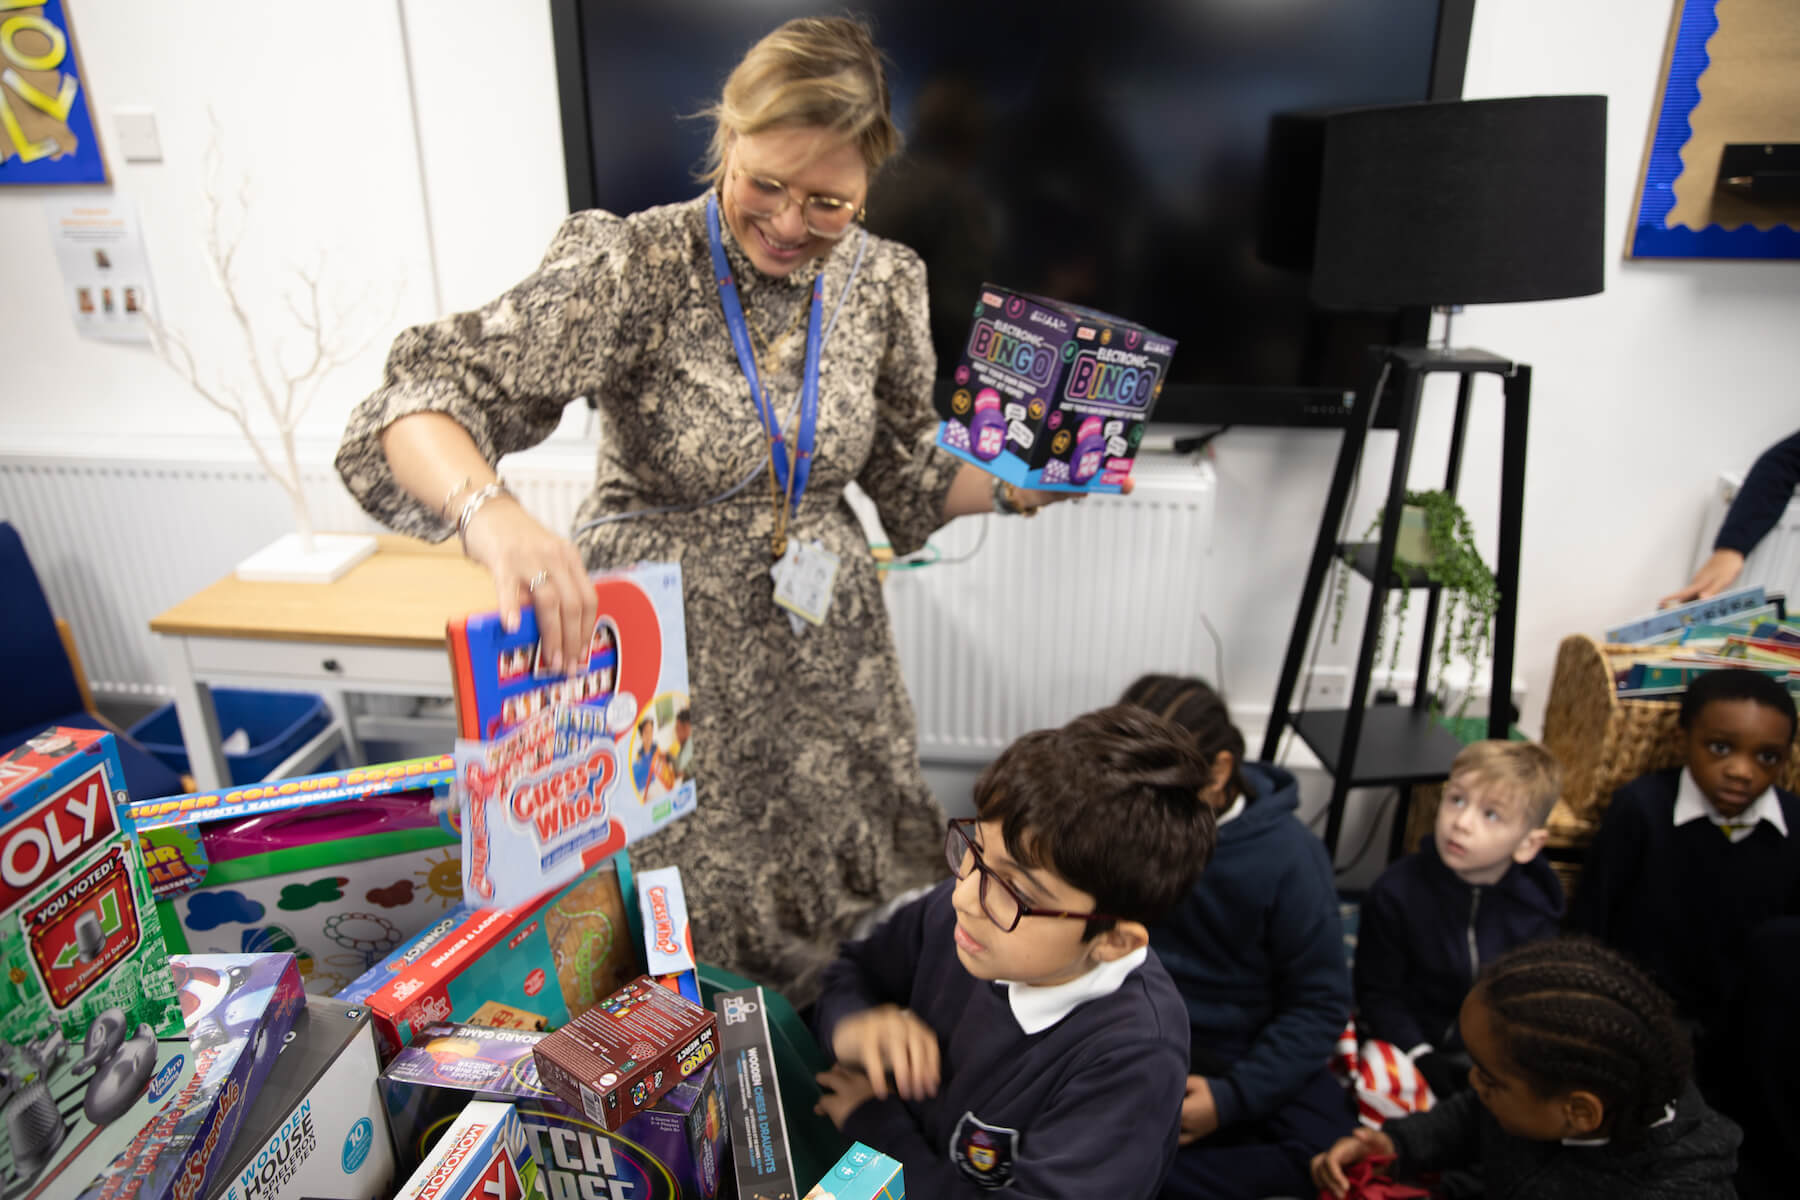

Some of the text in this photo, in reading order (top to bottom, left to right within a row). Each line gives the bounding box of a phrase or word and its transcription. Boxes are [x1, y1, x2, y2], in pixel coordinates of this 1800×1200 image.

[972, 324, 1054, 381] BINGO
[994, 319, 1045, 348] ELECTRONIC
[1096, 346, 1150, 368] ELECTRONIC
[1070, 356, 1155, 405] BINGO
[225, 776, 340, 804] COLOUR
[38, 858, 114, 924] YOU VOTED!
[456, 1027, 494, 1040] GAME
[676, 1027, 713, 1063] NO MERCY
[680, 1039, 715, 1076] UNO
[747, 1047, 762, 1086] WOODEN
[753, 1086, 767, 1115] CHESS
[190, 1080, 240, 1190] Scramble
[240, 1098, 311, 1187] WOODEN
[244, 1112, 314, 1200] HOUSE
[759, 1122, 777, 1174] DRAUGHTS
[420, 1123, 488, 1200] MONOPOLY
